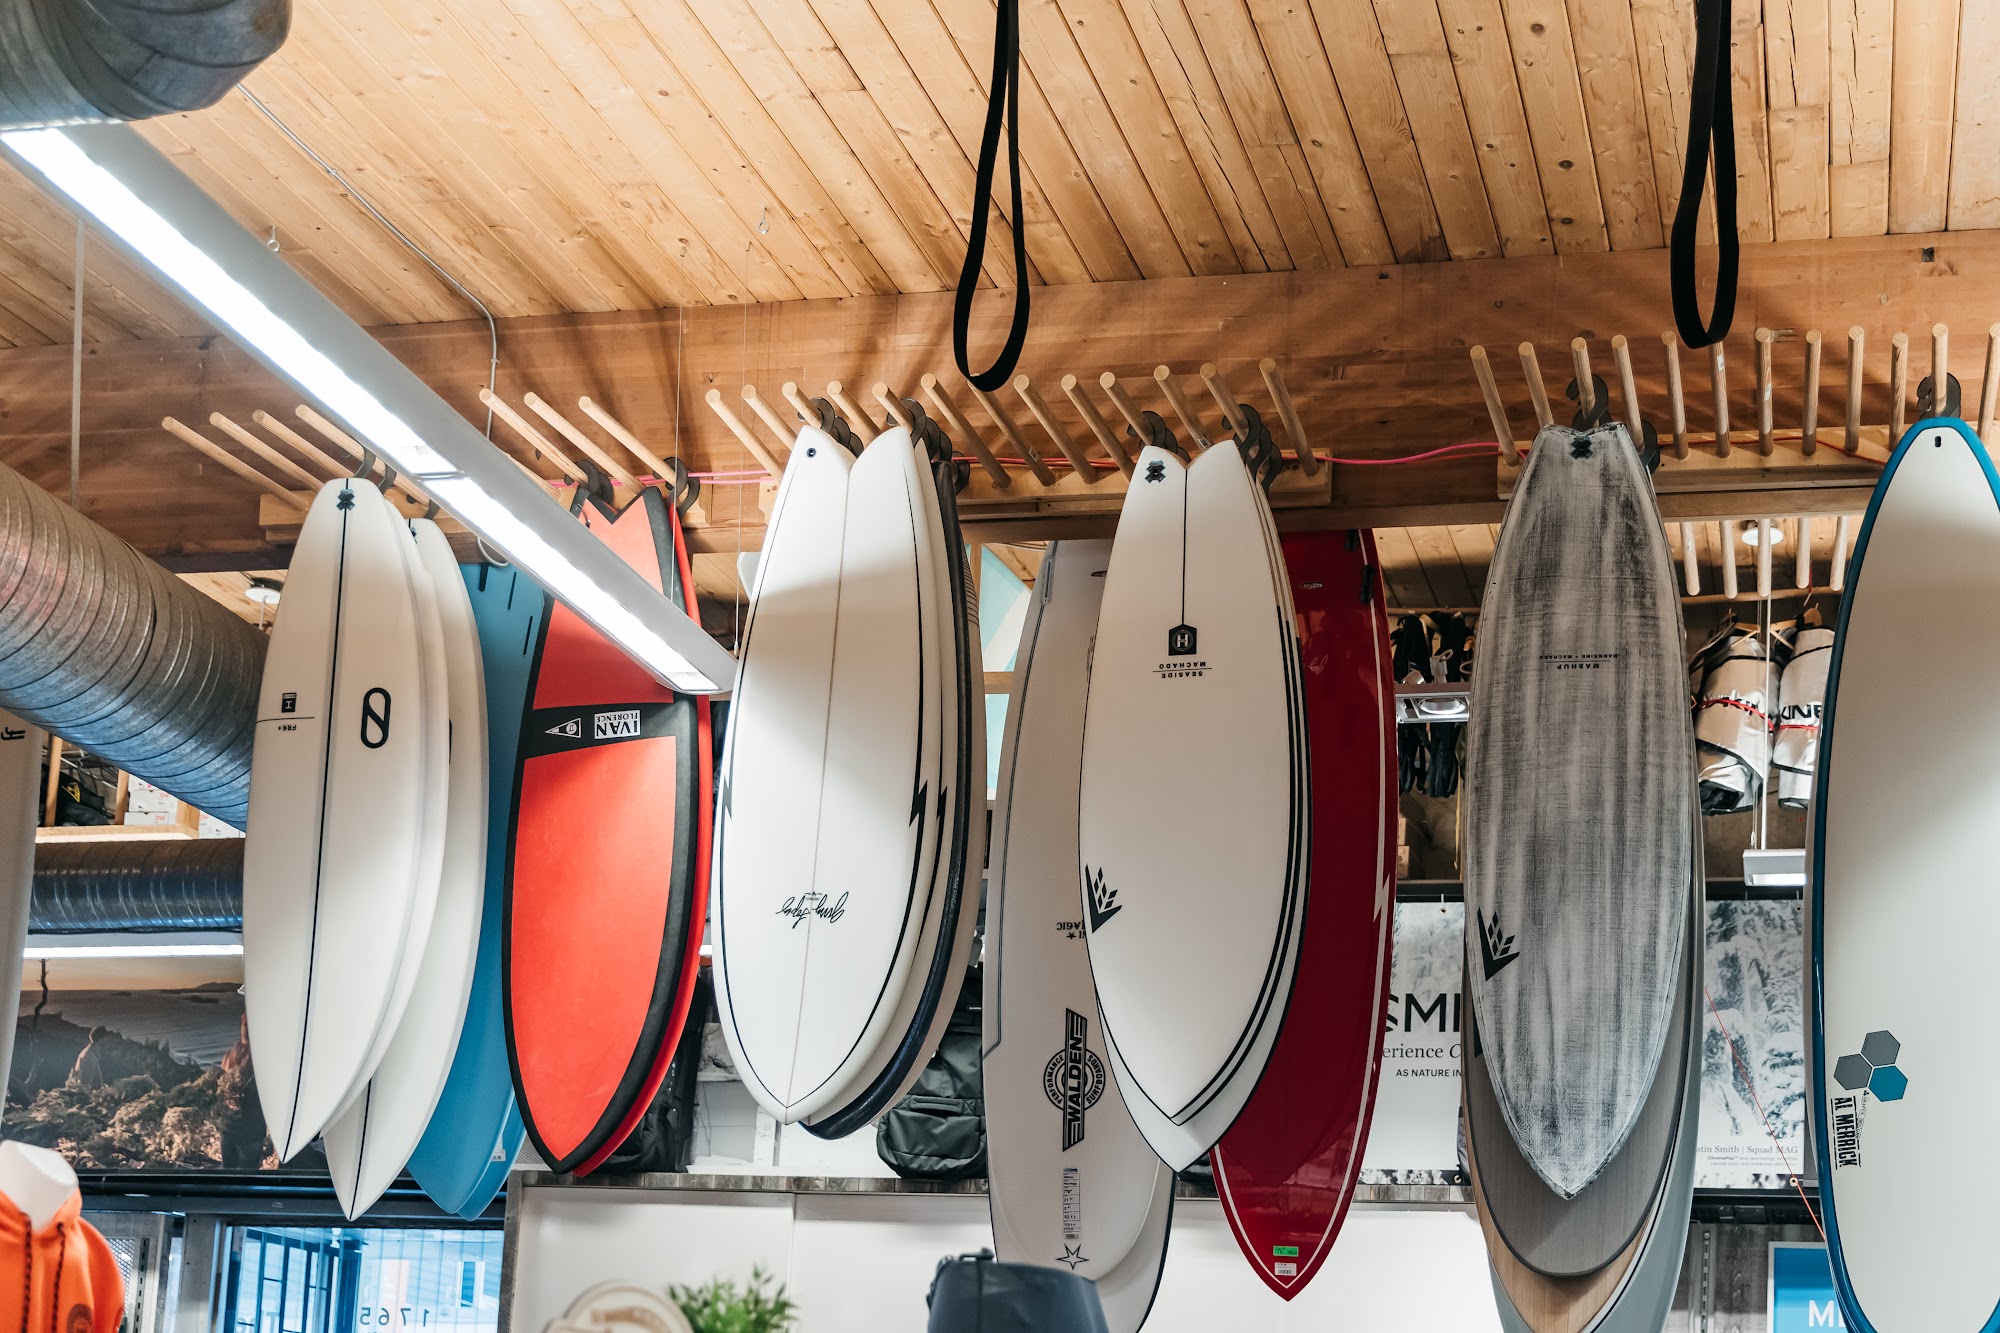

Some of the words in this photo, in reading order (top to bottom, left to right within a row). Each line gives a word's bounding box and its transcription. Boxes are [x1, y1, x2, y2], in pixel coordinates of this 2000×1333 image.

[1177, 634, 1188, 647] H
[1158, 661, 1206, 670] MACHADO
[1161, 671, 1203, 679] SEASIDE
[596, 712, 638, 723] FLORENCE
[596, 720, 638, 737] IVAN
[1382, 1043, 1444, 1059] erience
[1046, 1054, 1065, 1105] PERFORMANCE
[1067, 1035, 1083, 1123] WALDEN
[1086, 1054, 1103, 1105] SURFBOARDS
[1396, 1068, 1409, 1077] AS
[1411, 1068, 1450, 1077] NATURE
[1452, 1068, 1462, 1077] IN
[1834, 1097, 1853, 1111] AL
[1835, 1113, 1858, 1168] MERRICK
[1714, 1145, 1740, 1154] Smith
[1746, 1145, 1774, 1156] Squad
[1775, 1145, 1798, 1154] MAG
